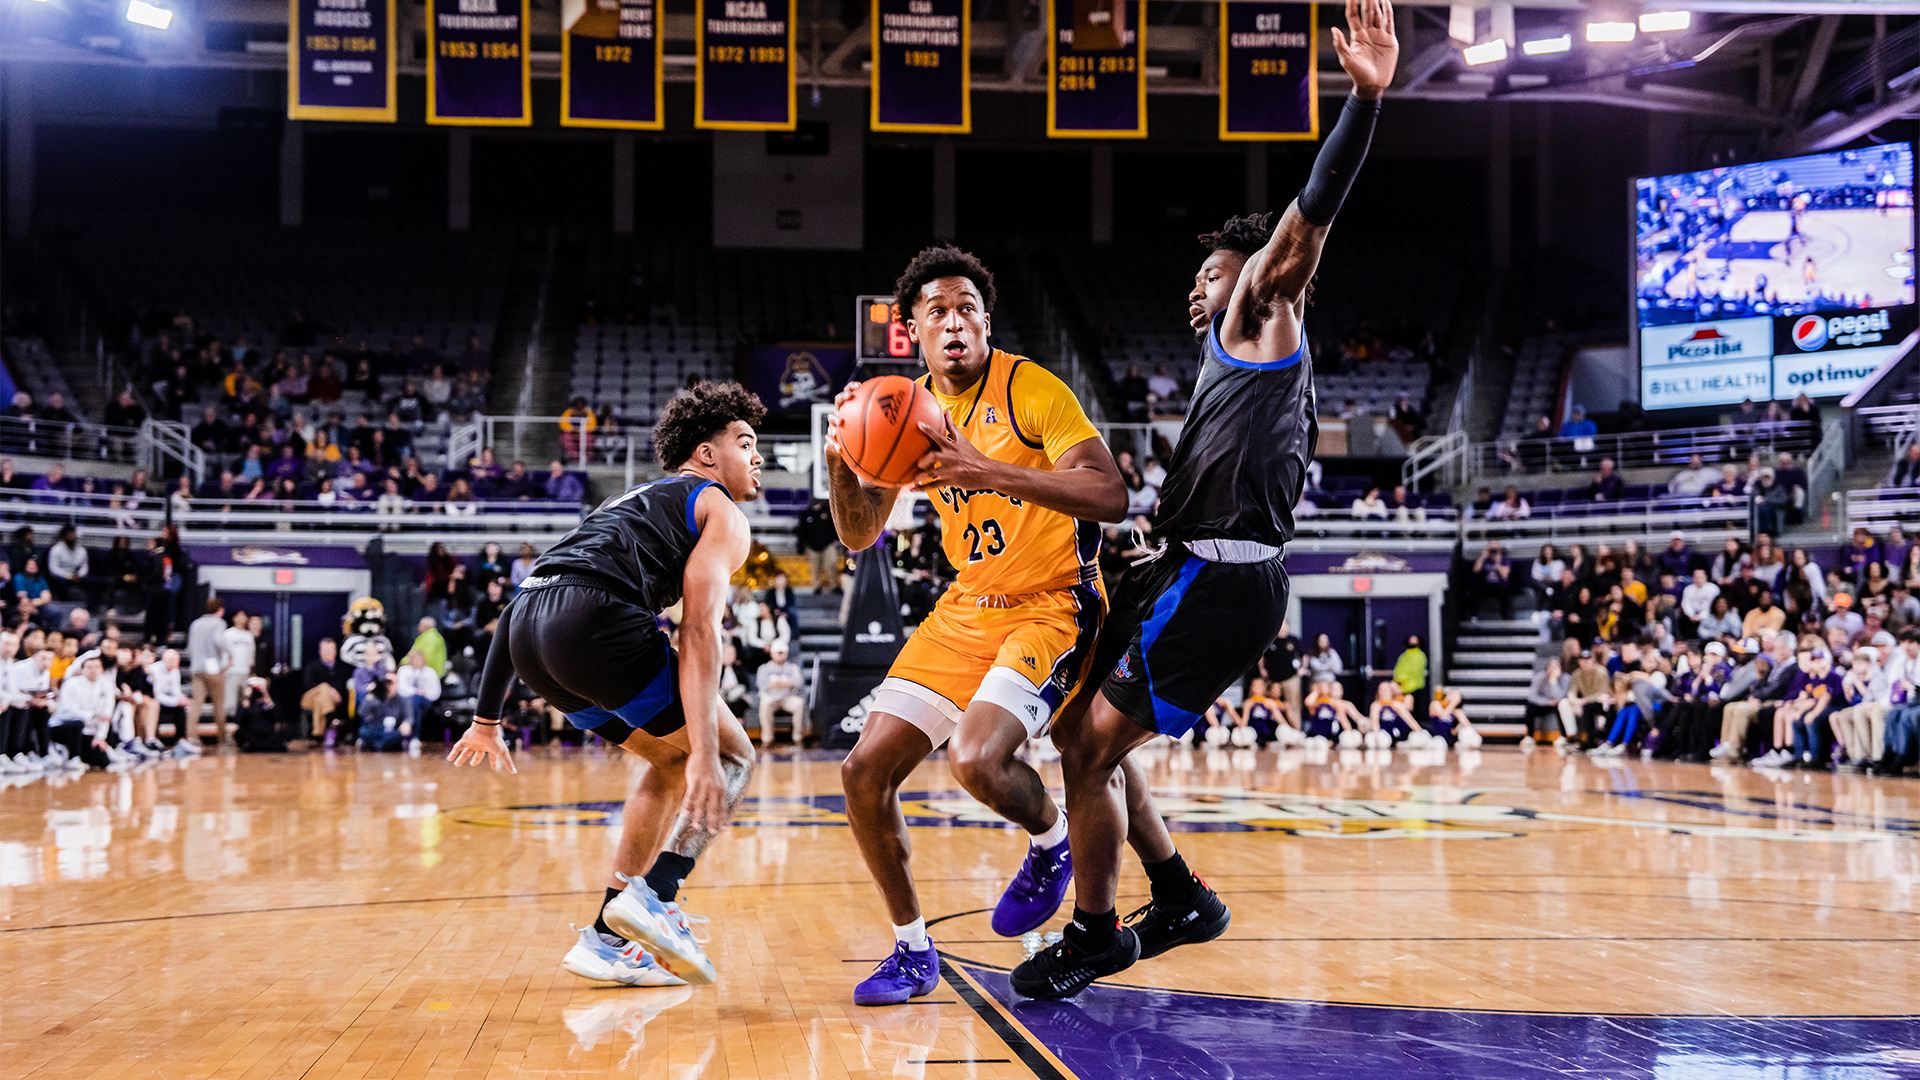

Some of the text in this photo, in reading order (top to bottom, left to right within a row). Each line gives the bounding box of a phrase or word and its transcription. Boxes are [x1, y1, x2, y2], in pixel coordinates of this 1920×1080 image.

[725, 1, 767, 18] NCAA
[708, 19, 784, 35] TOURNAMENT
[883, 13, 959, 29] TOURNAMENT
[1256, 13, 1282, 31] CIT
[883, 28, 960, 47] CHAMPIONS
[1231, 31, 1307, 48] CHAMPIONS
[440, 41, 519, 59] 1953 1954
[596, 45, 632, 63] 1972
[709, 45, 785, 63] 1972 1993
[905, 50, 940, 68] 1993
[1059, 56, 1135, 73] 2011 2013
[1251, 59, 1288, 75] 2013
[1059, 74, 1096, 91] 2014
[1828, 309, 1891, 340] pepsi
[889, 322, 911, 357] 6
[1664, 373, 1767, 394] ECU HEALTH
[962, 518, 1007, 565] 23
